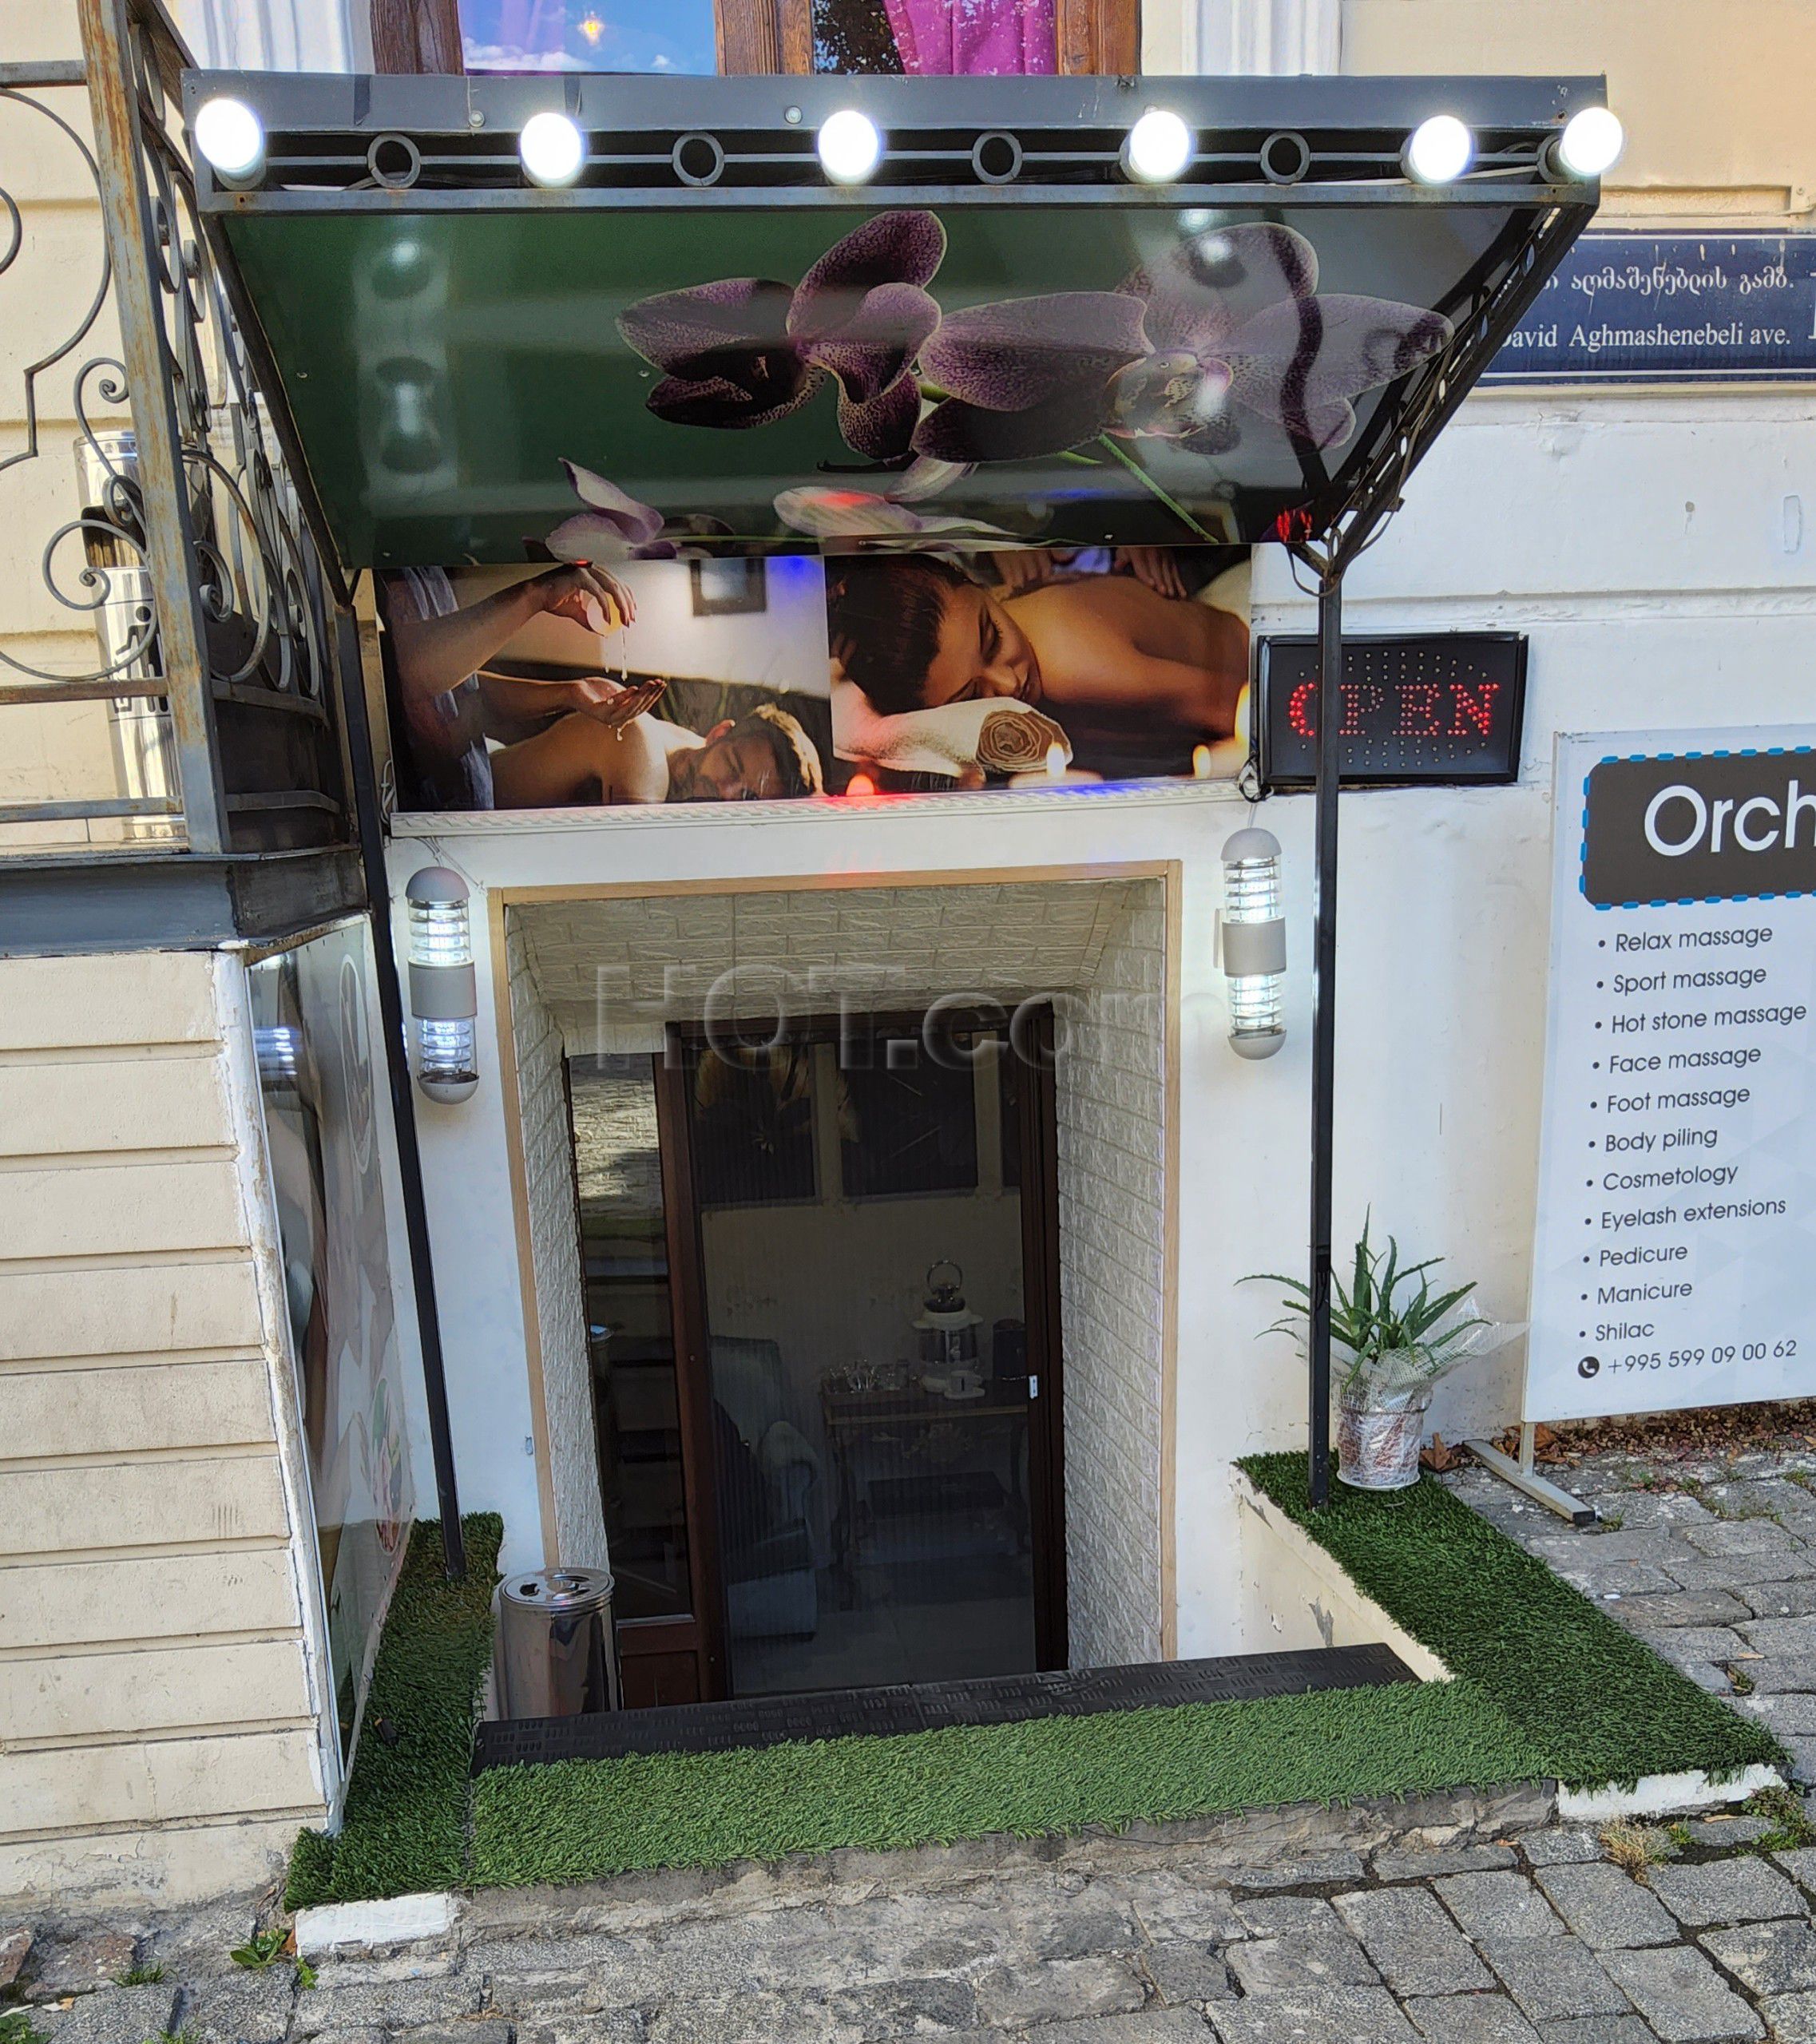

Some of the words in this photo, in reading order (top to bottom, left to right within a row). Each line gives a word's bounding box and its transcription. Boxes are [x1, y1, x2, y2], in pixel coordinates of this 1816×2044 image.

[1571, 264, 1727, 296] აღმაშენებლის
[1568, 322, 1743, 353] Aghmashenebeli
[1750, 327, 1790, 345] ave.
[1615, 931, 1671, 952] Relax
[1679, 927, 1773, 949] massage
[1613, 971, 1667, 996] Sport
[1673, 968, 1767, 988] massage
[1612, 1013, 1647, 1034] Hot
[1651, 1011, 1707, 1032] stone
[1714, 1004, 1807, 1026] massage
[1609, 1055, 1662, 1074] Face
[1668, 1048, 1762, 1068] massage
[1607, 1091, 1651, 1114] Foot
[1657, 1087, 1751, 1108] massage
[1605, 1131, 1657, 1152] Body
[1662, 1127, 1718, 1151] piling
[1603, 1165, 1739, 1191] Cosmetology
[1601, 1206, 1677, 1232] Eyelash
[1683, 1198, 1786, 1222] extensions
[1599, 1245, 1688, 1267] Pedicure
[1597, 1281, 1693, 1305] Manicure
[1595, 1322, 1655, 1341] Shilac
[1608, 1353, 1661, 1374] +995
[1667, 1348, 1705, 1368] 599
[1711, 1345, 1736, 1364] 09
[1742, 1342, 1766, 1361] 00
[1773, 1340, 1797, 1357] 62
